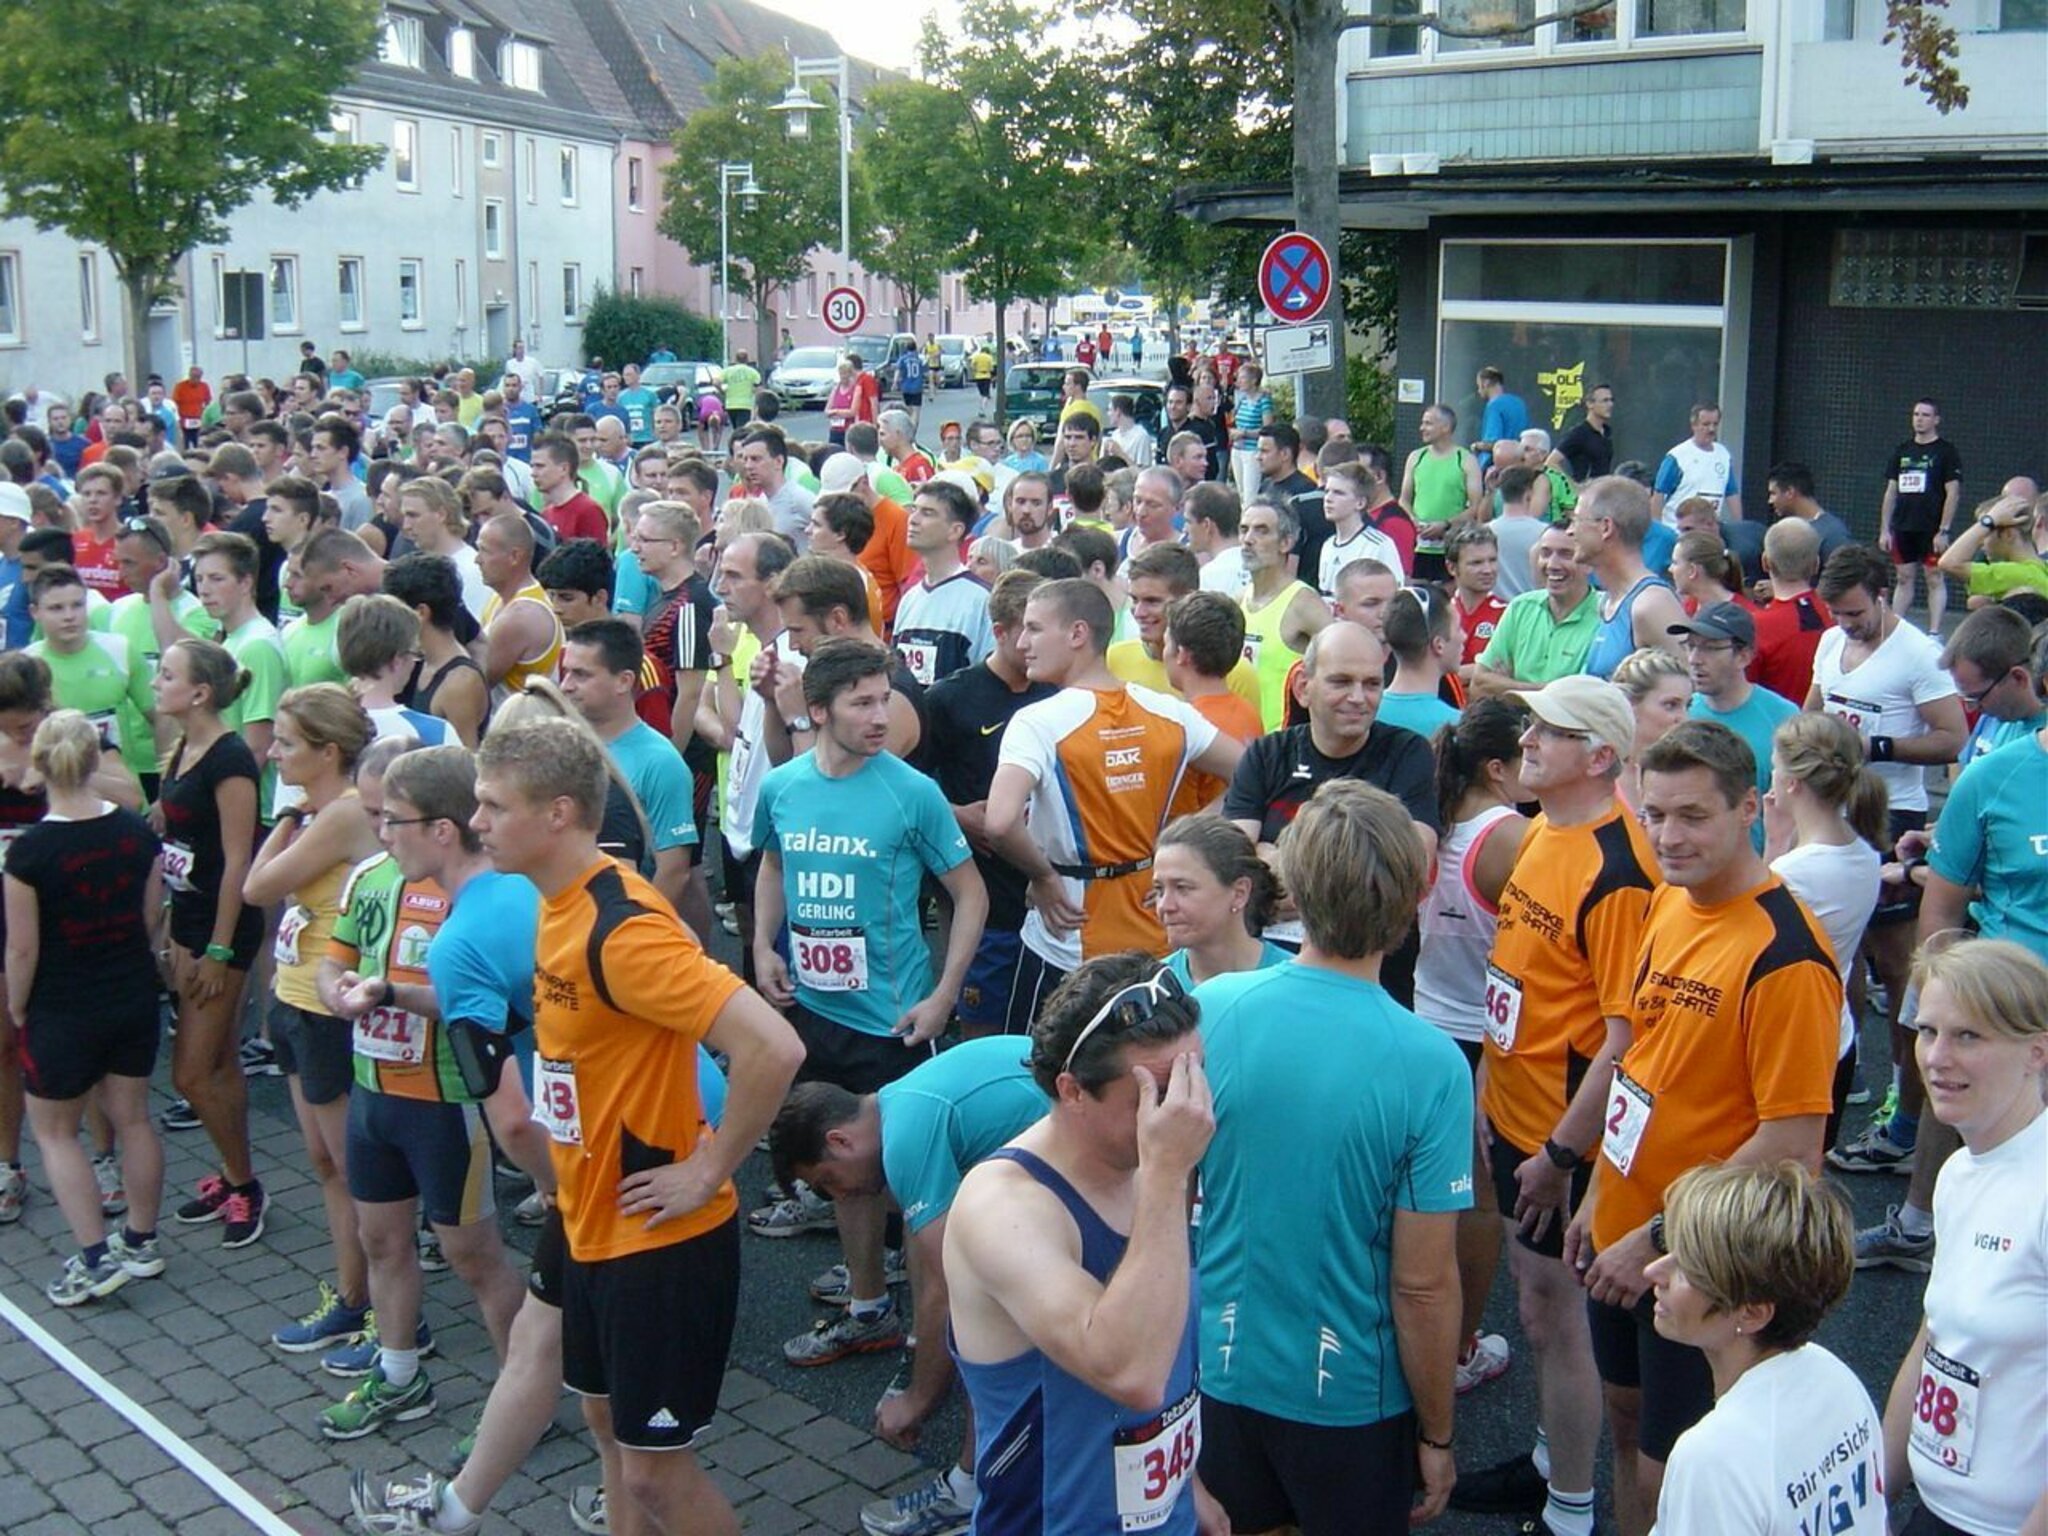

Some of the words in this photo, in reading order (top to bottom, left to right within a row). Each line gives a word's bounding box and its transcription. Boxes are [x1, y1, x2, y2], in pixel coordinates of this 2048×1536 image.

[831, 300, 857, 321] 30
[904, 360, 920, 378] 10
[1105, 747, 1141, 768] DAK
[783, 826, 878, 858] talanx.
[797, 871, 856, 899] HDI
[797, 902, 856, 920] GERLING
[799, 942, 854, 974] 308
[360, 1007, 411, 1043] 421
[1607, 1095, 1628, 1136] 2
[1974, 1231, 2000, 1251] VGH
[1915, 1374, 1959, 1436] 88
[1143, 1418, 1195, 1501] 345
[1786, 1471, 1817, 1509] fair
